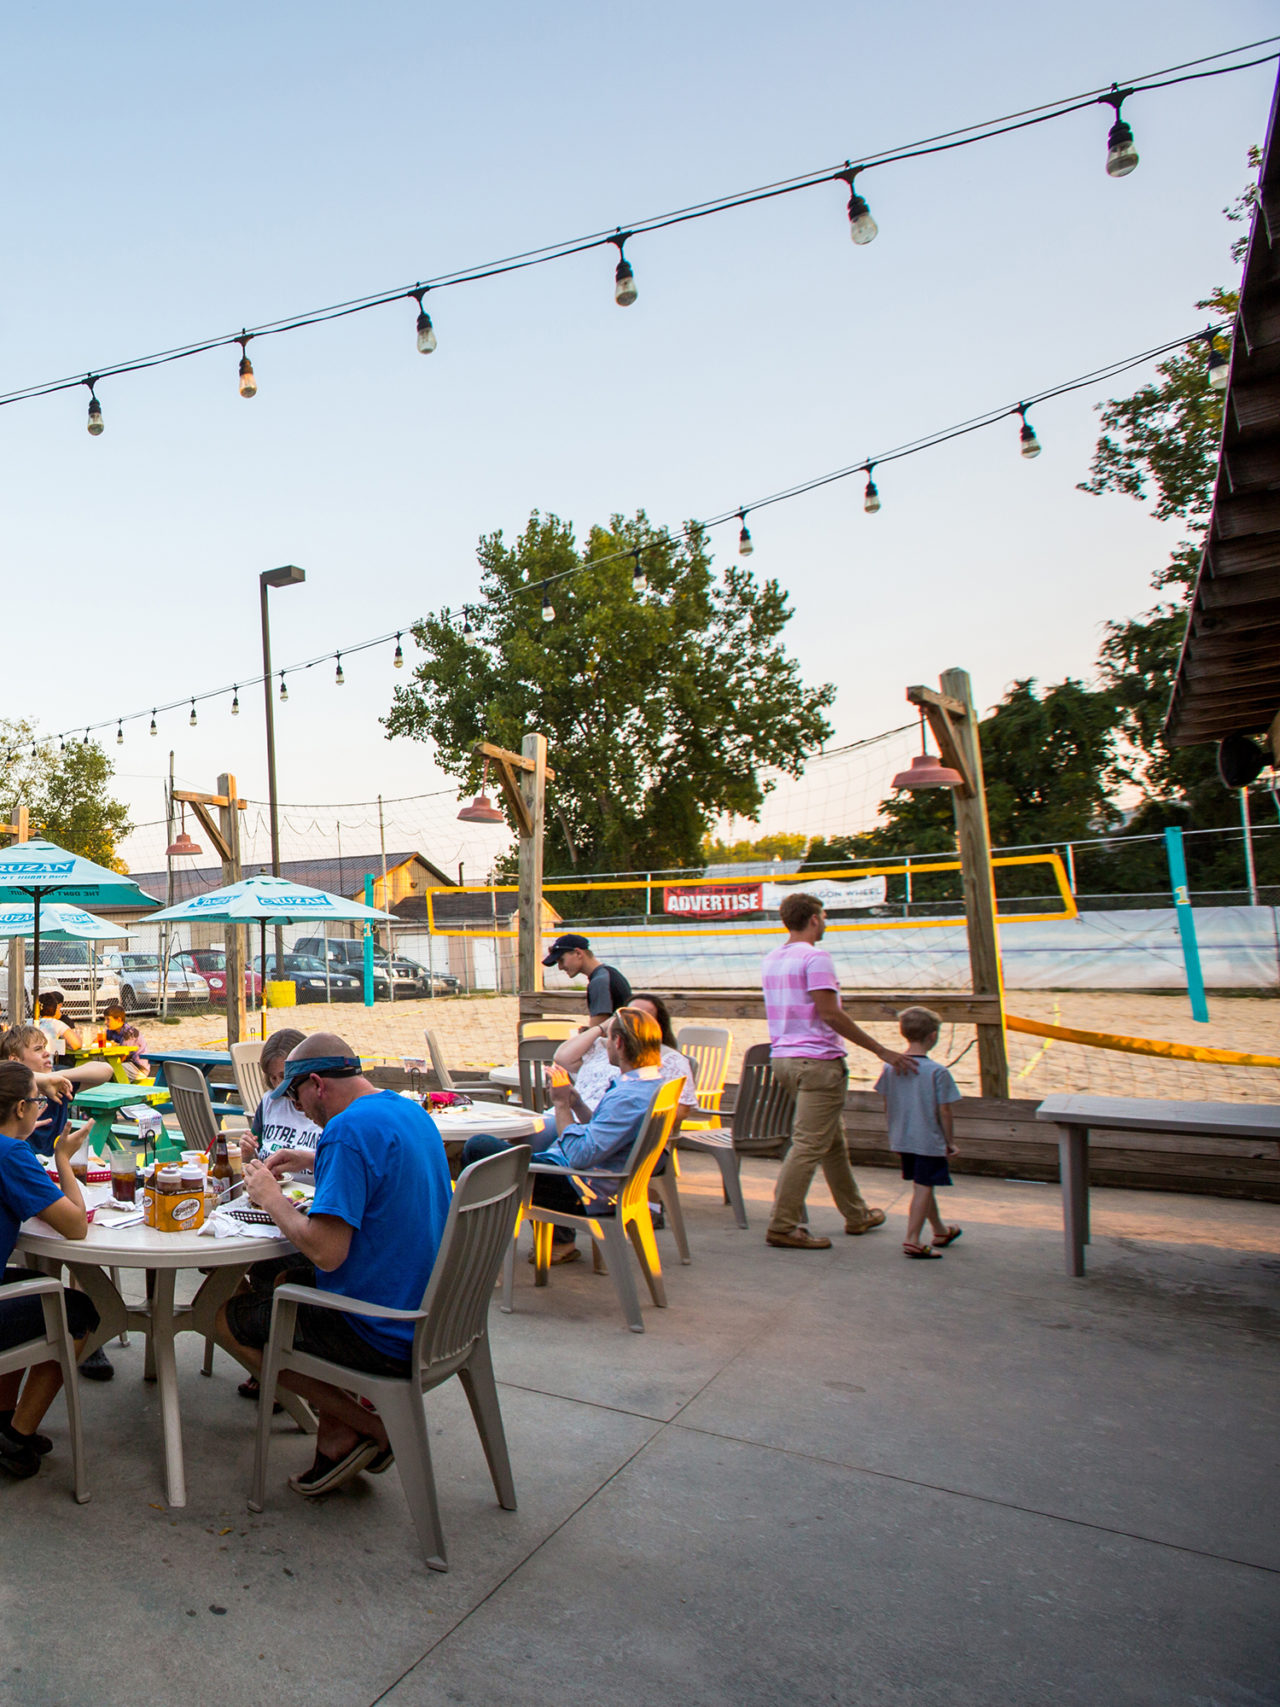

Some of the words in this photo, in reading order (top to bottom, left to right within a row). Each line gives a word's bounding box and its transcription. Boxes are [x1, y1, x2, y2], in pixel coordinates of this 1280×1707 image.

[260, 897, 326, 905] CRUZAN
[667, 893, 759, 911] ADVERTISE
[1176, 886, 1191, 905] 1
[363, 923, 371, 936] 1
[263, 1124, 296, 1144] NOTRE
